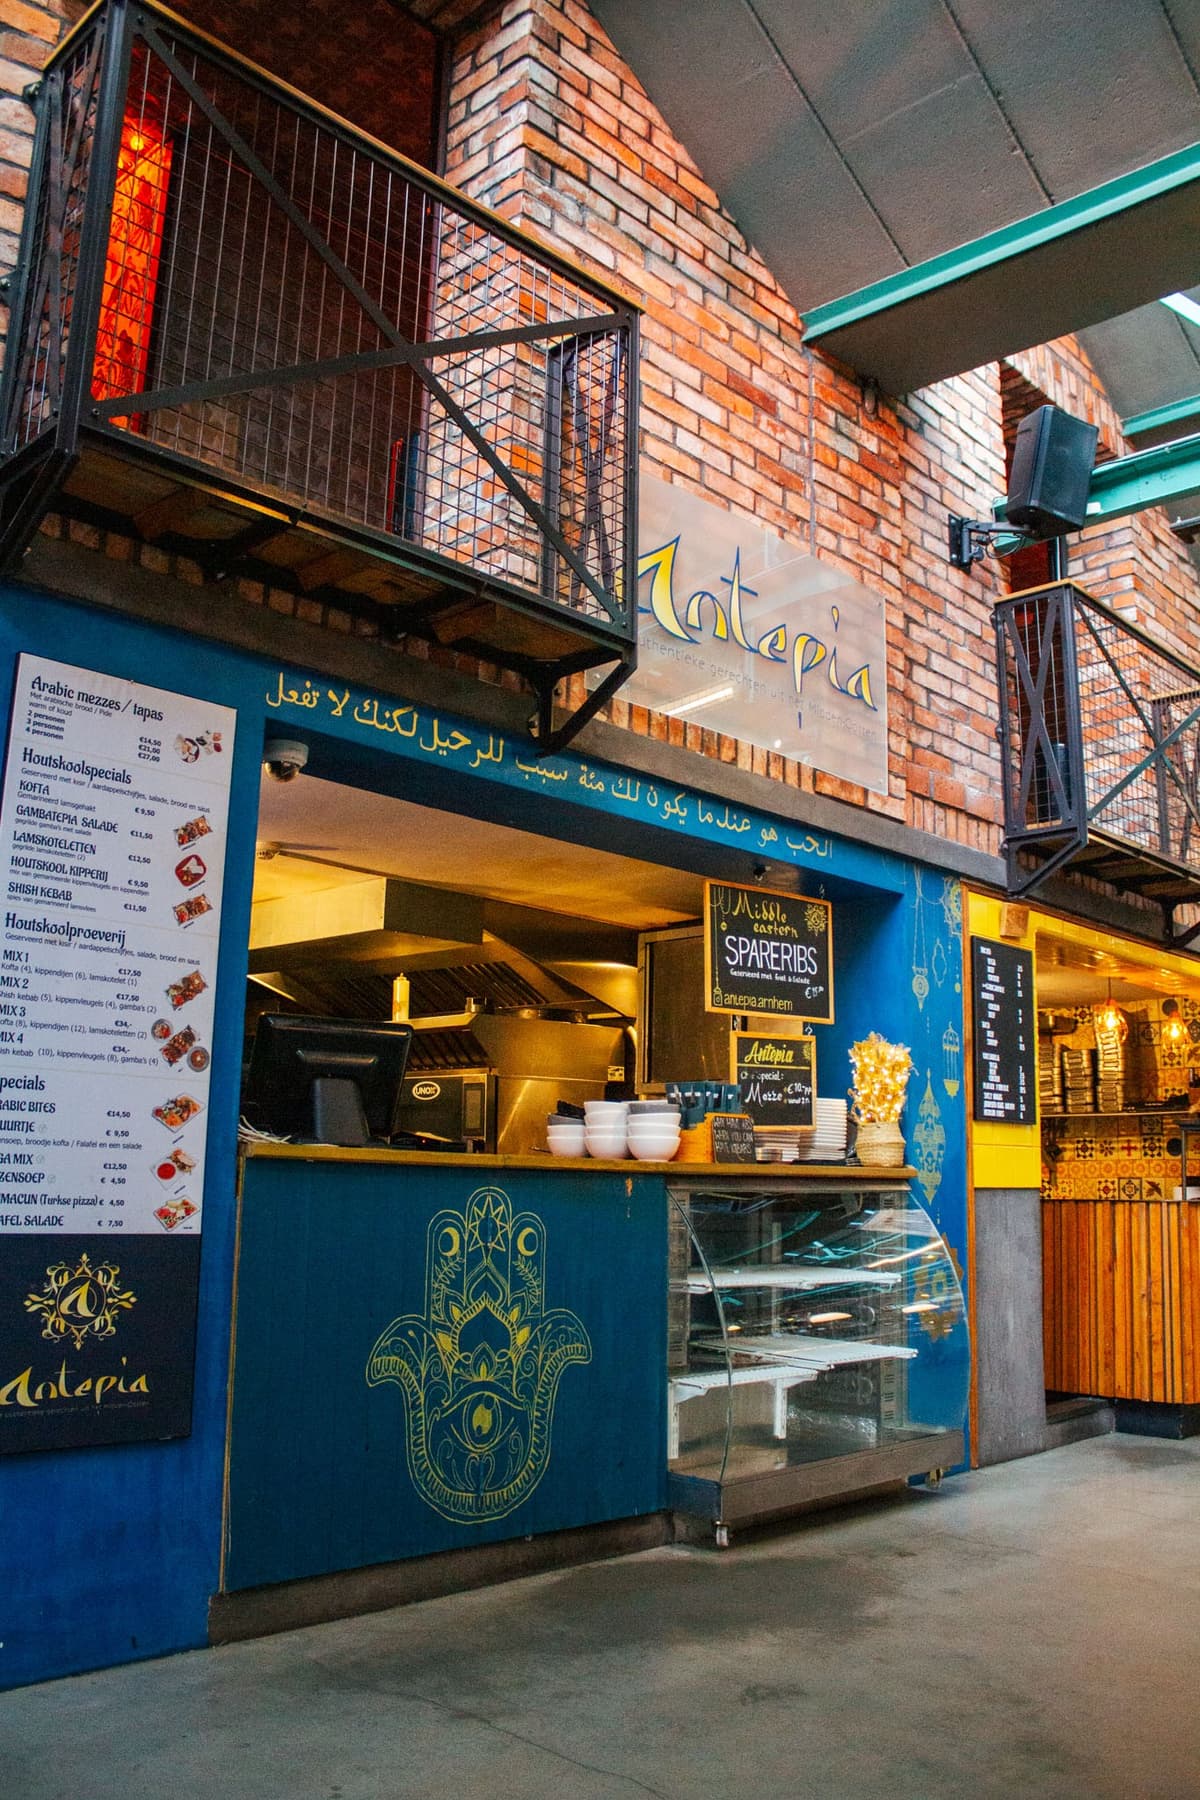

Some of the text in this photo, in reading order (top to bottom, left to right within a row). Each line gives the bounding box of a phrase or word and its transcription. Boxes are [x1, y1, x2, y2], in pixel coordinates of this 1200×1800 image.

[638, 637, 705, 669] uthentieke
[31, 675, 164, 722] Arabic mezzes tapas
[266, 672, 321, 708] تفعل
[327, 688, 351, 717] لا
[32, 720, 64, 732] personen
[34, 712, 65, 724] personen
[353, 698, 420, 737] لكنك
[31, 728, 63, 740] personen
[22, 747, 132, 784] Houtskoolspecials
[515, 755, 568, 783] سبب
[20, 779, 50, 796] KOFTA
[578, 763, 606, 793] مئة
[611, 775, 641, 803] لك
[16, 804, 153, 840] GAMBATEPIA SALADE €11,50
[697, 799, 752, 834] عندما
[13, 830, 151, 864] LAMSKOTELETTEN €12,50
[757, 826, 779, 848] هو
[785, 836, 834, 859] الحب
[10, 855, 68, 875] HOUTSKOOL
[69, 865, 109, 882] KIPPERIJ
[8, 881, 147, 913] SHISH KEBAB €11,50
[732, 891, 787, 924] Middle
[5, 911, 126, 949] Houtskoolproeverij
[5, 932, 43, 944] Geserveerd
[753, 922, 799, 939] eastern
[3, 949, 142, 977] MIX 1 €17,50
[725, 935, 818, 975] SPARERIBS
[1, 963, 19, 972] Kofta
[35, 967, 74, 979] kippendijen
[0, 975, 140, 1002] MIX 2 €17,50
[17, 992, 39, 1003] kebab
[146, 1005, 157, 1014] (2)
[19, 1006, 27, 1018] 3
[16, 1033, 24, 1044] 4
[30, 1020, 70, 1032] kippendijen
[137, 1031, 148, 1040] (2)
[12, 1048, 34, 1058] kebab
[148, 1057, 159, 1066] (4)
[744, 1041, 795, 1065] Antepia
[28, 1101, 56, 1114] BITES
[106, 1110, 131, 1118] €14,50
[25, 1138, 52, 1148] broodje
[52, 1138, 70, 1147] kofta
[13, 1153, 34, 1165] MIX
[103, 1163, 127, 1171] €12,50
[110, 1177, 126, 1185] 4,50
[40, 1193, 72, 1206] (Turkse
[72, 1194, 98, 1209] pizza)
[109, 1199, 125, 1207] 4,50
[24, 1214, 65, 1227] SALADE
[0, 1356, 150, 1408] Antepia
